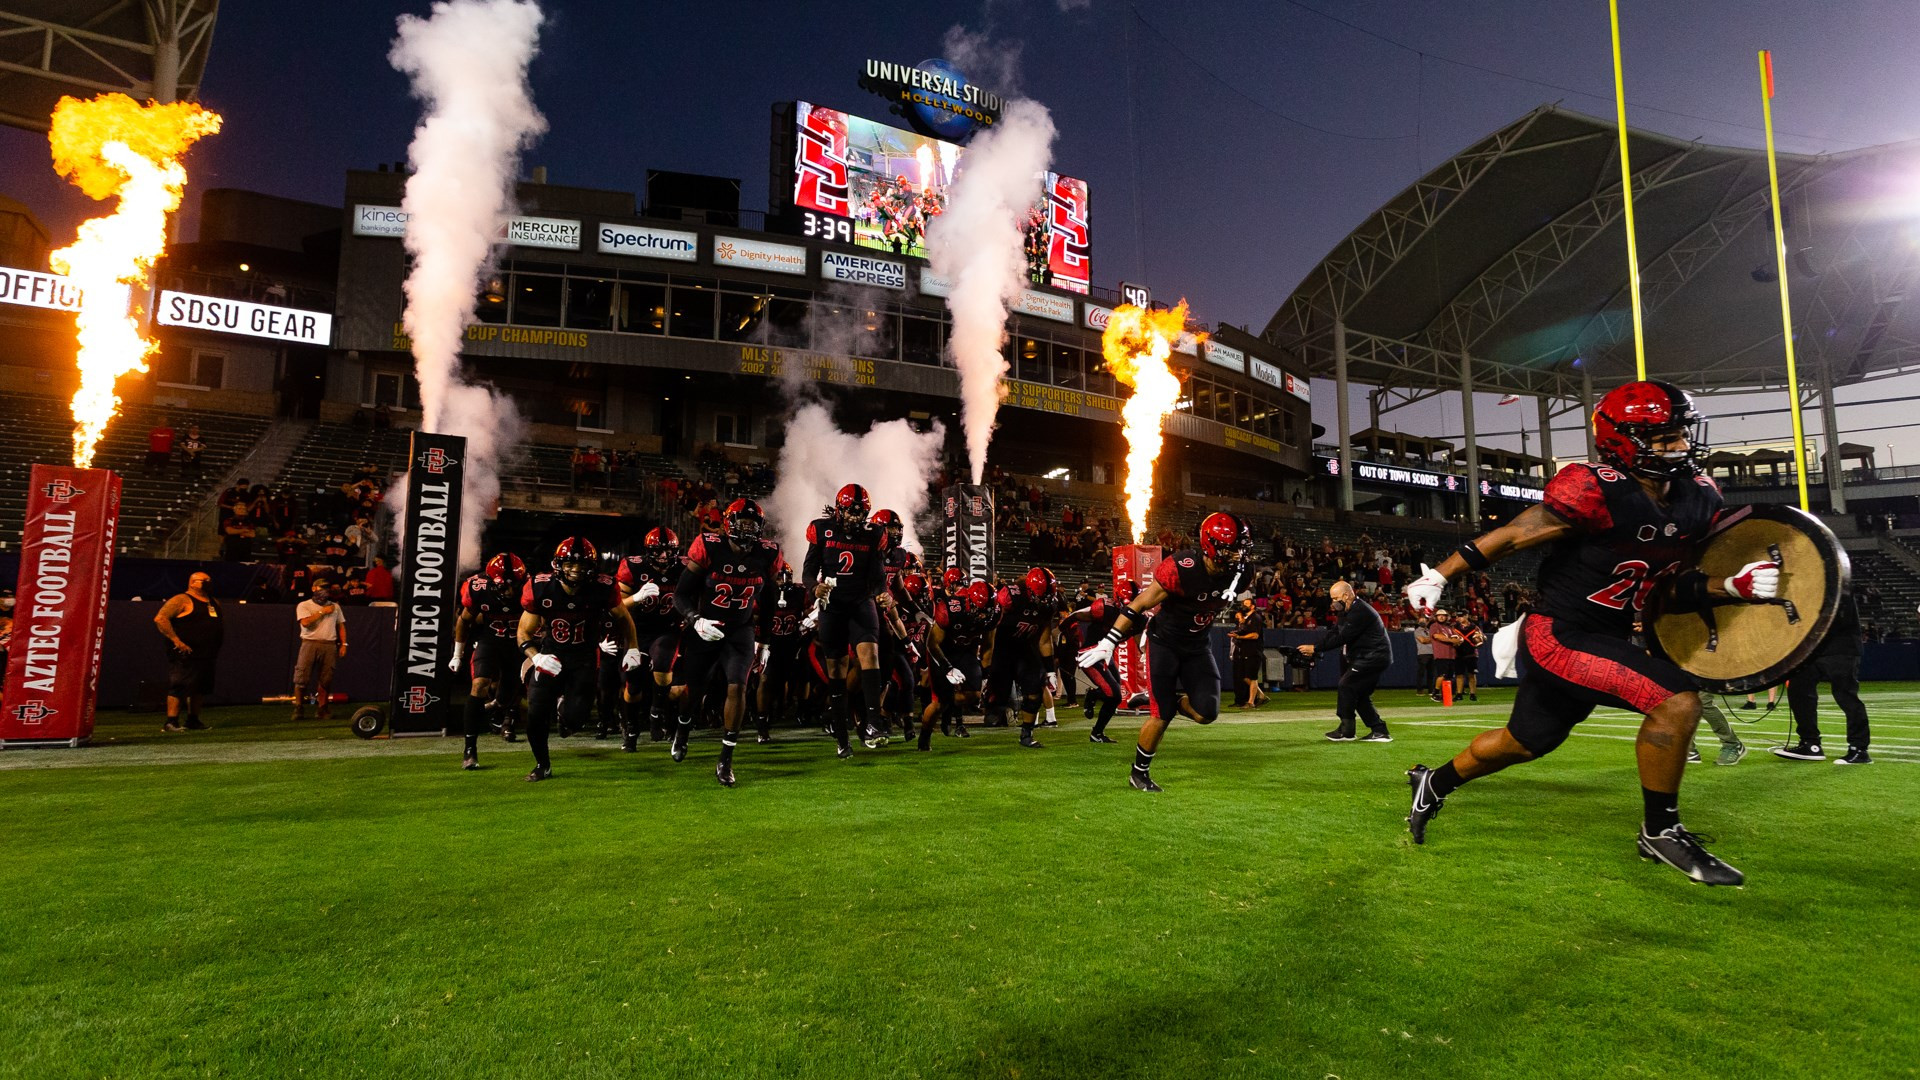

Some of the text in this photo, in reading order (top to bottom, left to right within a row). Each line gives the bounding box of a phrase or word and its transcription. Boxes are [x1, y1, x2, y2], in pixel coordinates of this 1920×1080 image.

[866, 58, 1011, 113] UNIVERSAL STUDIO
[901, 90, 993, 125] HOLLYWOOD
[361, 224, 391, 233] banking
[510, 231, 578, 244] INSURANCE
[511, 221, 578, 235] MERCURY
[804, 212, 850, 243] 3:39
[601, 228, 688, 252] Spectrum
[740, 249, 772, 262] Dignity
[823, 253, 903, 276] AMERICAN
[835, 268, 905, 288] EXPRESS
[1025, 293, 1072, 310] Dignity Health
[1026, 302, 1062, 316] Sports Park
[1125, 287, 1148, 309] 40
[169, 296, 316, 340] SDSU GEAR
[467, 325, 589, 348] CUP CHAMPIONS
[741, 346, 769, 362] MLS
[741, 361, 765, 374] 2002
[855, 373, 876, 385] 2014
[1255, 362, 1277, 385] Modelo
[1021, 396, 1039, 408] 2002
[1043, 399, 1060, 412] 2010
[1063, 402, 1079, 415] 2011
[1086, 395, 1116, 411] SHIELD
[1359, 465, 1377, 478] OUT
[1377, 467, 1388, 479] OF
[1389, 469, 1412, 483] TOWN
[1412, 472, 1439, 487] SCORES
[1500, 484, 1521, 498] CLOSED
[836, 550, 854, 576] 2
[407, 481, 450, 679] AZTEC FOOTBALL
[23, 510, 76, 693] AZTEC FOOTBALL
[90, 516, 116, 692] AZTEC FOOTBALL
[711, 583, 755, 610] 24
[550, 618, 586, 645] 81
